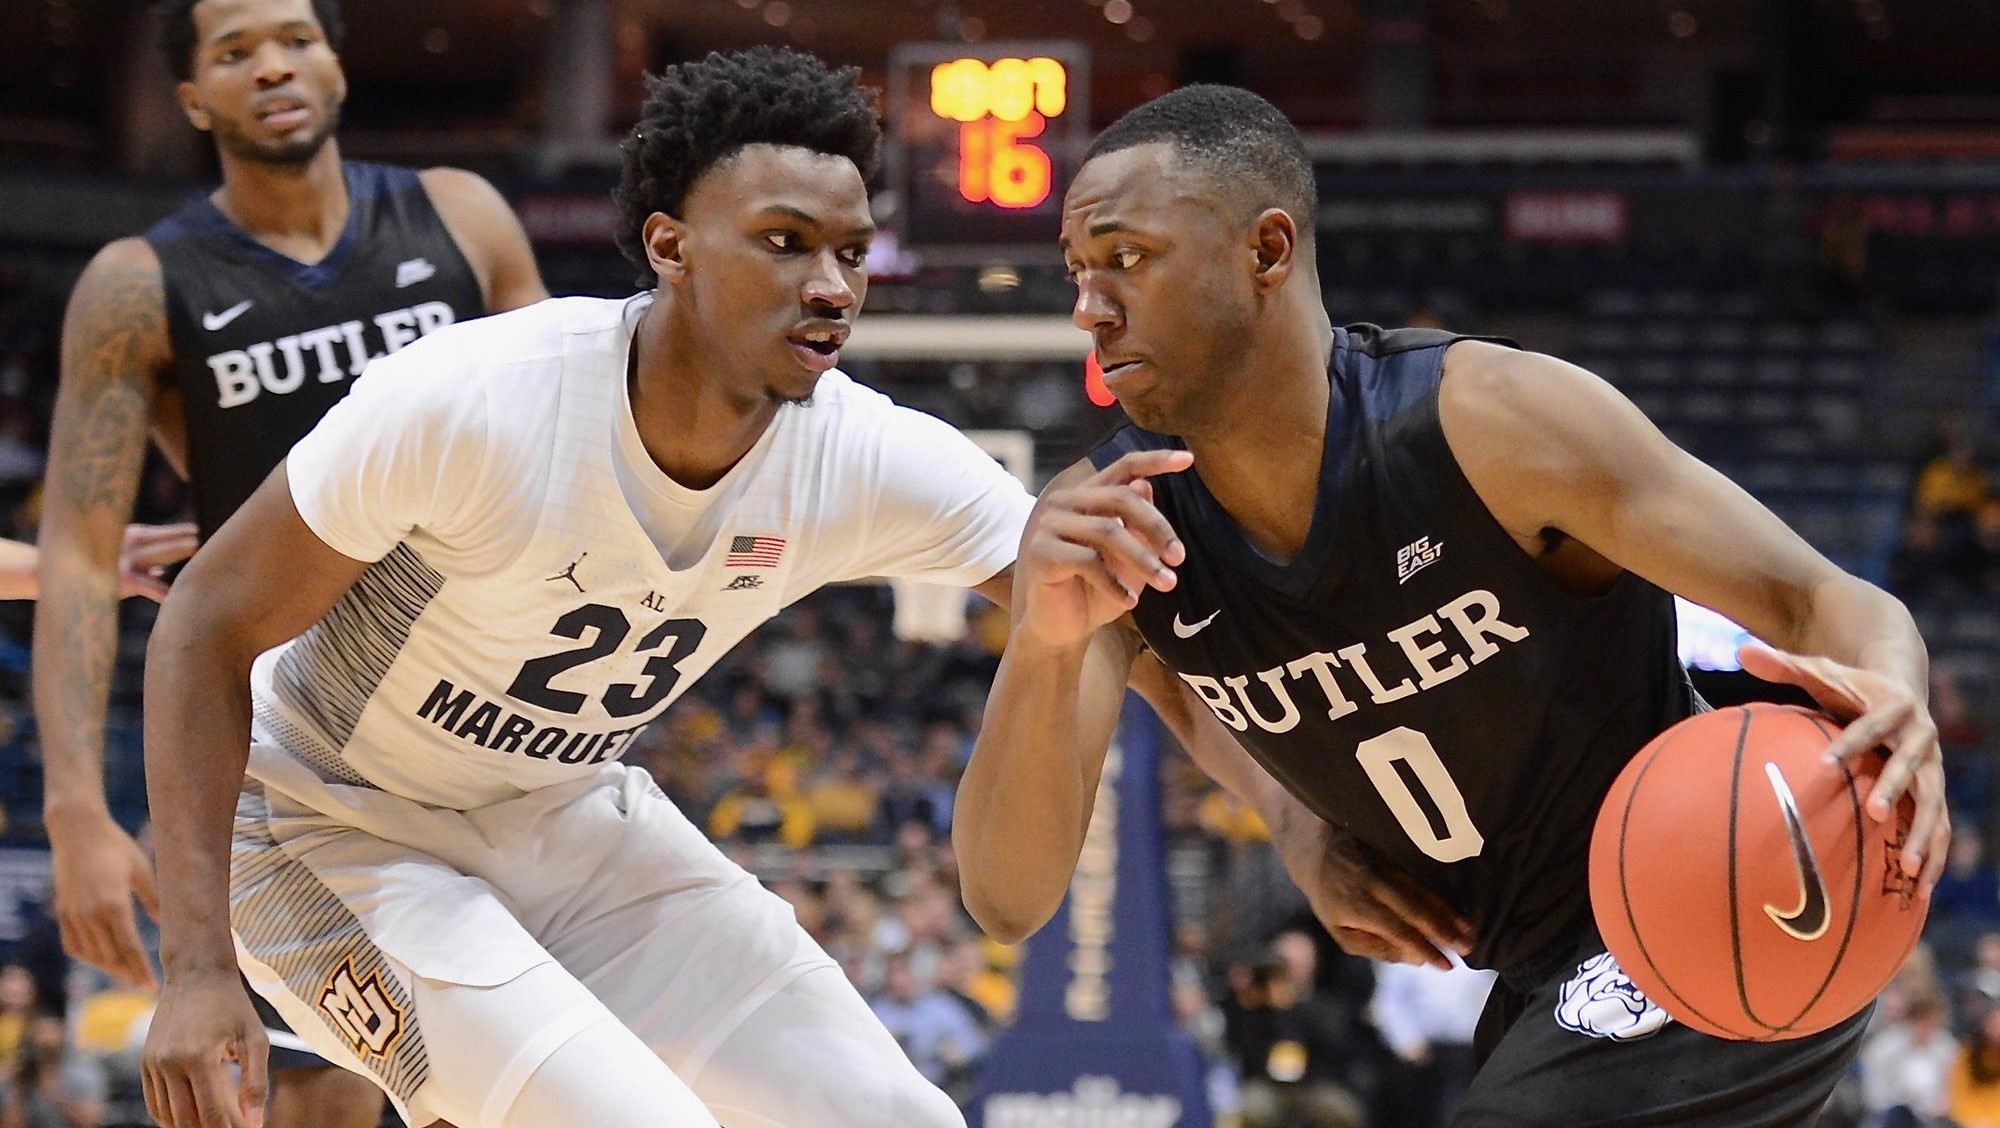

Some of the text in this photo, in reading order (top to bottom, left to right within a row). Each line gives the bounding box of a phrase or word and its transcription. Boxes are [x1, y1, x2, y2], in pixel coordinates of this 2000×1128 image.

[1396, 535, 1429, 565] BIG
[1397, 541, 1444, 578] EAST
[640, 590, 666, 613] AL
[505, 603, 708, 718] 23
[1177, 589, 1530, 734] BUTLER
[1355, 725, 1485, 864] 0
